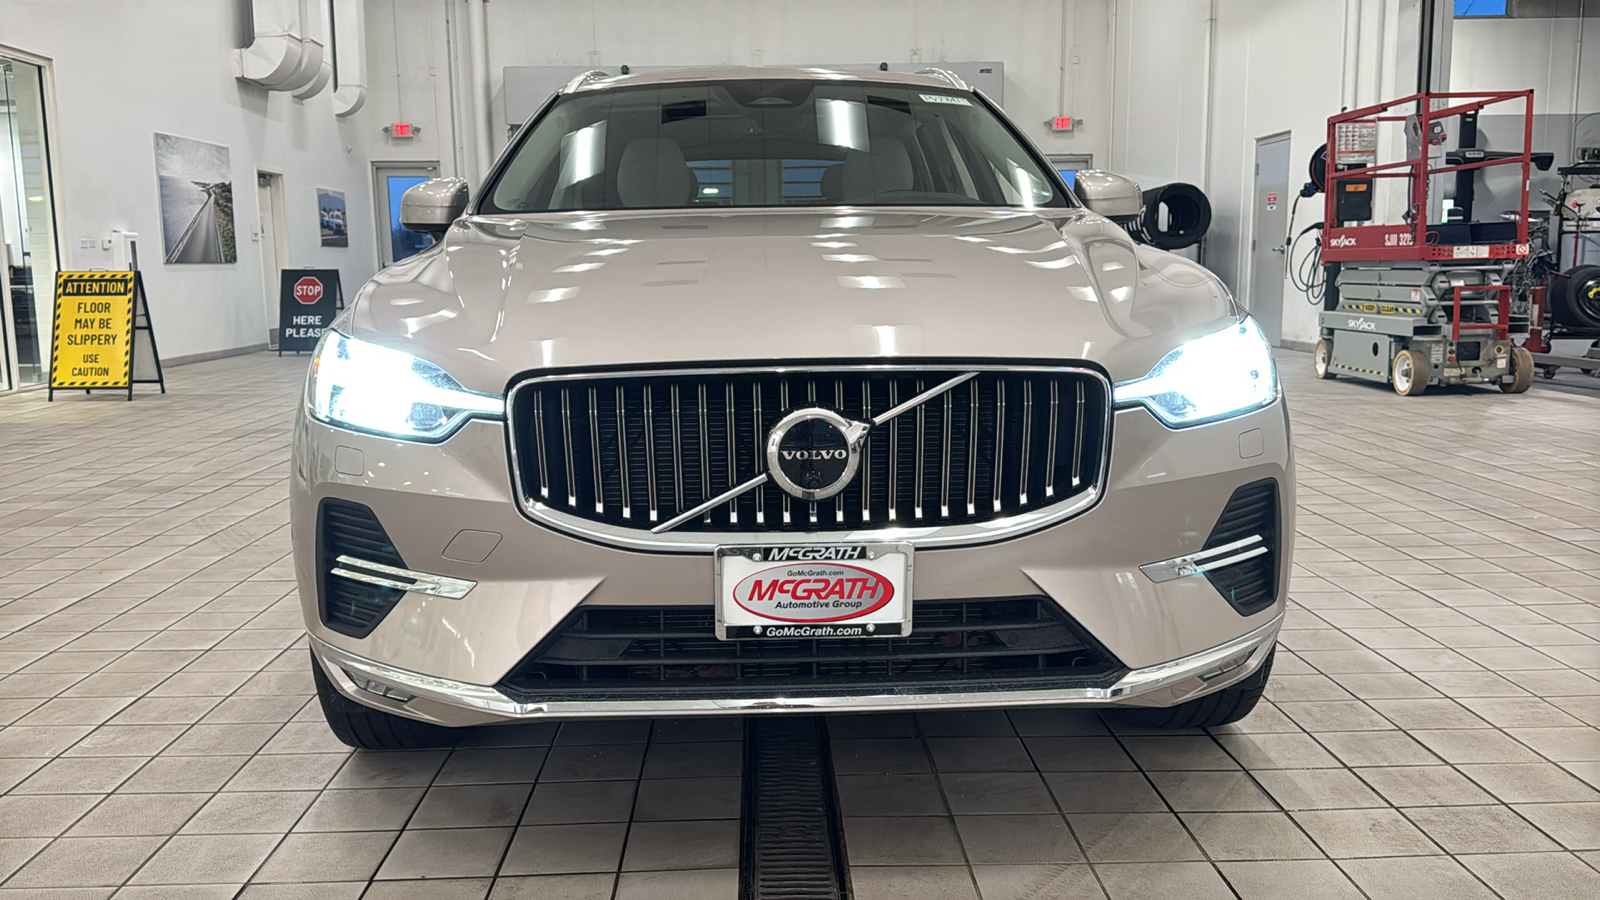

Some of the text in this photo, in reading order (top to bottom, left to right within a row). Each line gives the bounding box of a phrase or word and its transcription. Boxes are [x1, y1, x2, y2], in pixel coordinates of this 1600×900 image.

[65, 281, 125, 294] ATTENTION
[296, 285, 321, 296] STOP
[77, 302, 111, 314] FLOOR
[74, 318, 112, 330] MAY BE
[292, 315, 322, 325] HERE
[1347, 317, 1376, 330] SKYJACK
[67, 334, 118, 346] SLIPPERY
[82, 353, 100, 364] USE
[71, 367, 110, 377] CAUTION
[780, 449, 847, 460] VOLVO
[787, 569, 844, 577] GoMcGrath.com
[774, 600, 863, 610] Automotive Group
[766, 625, 862, 638] GoMcGrath.com
